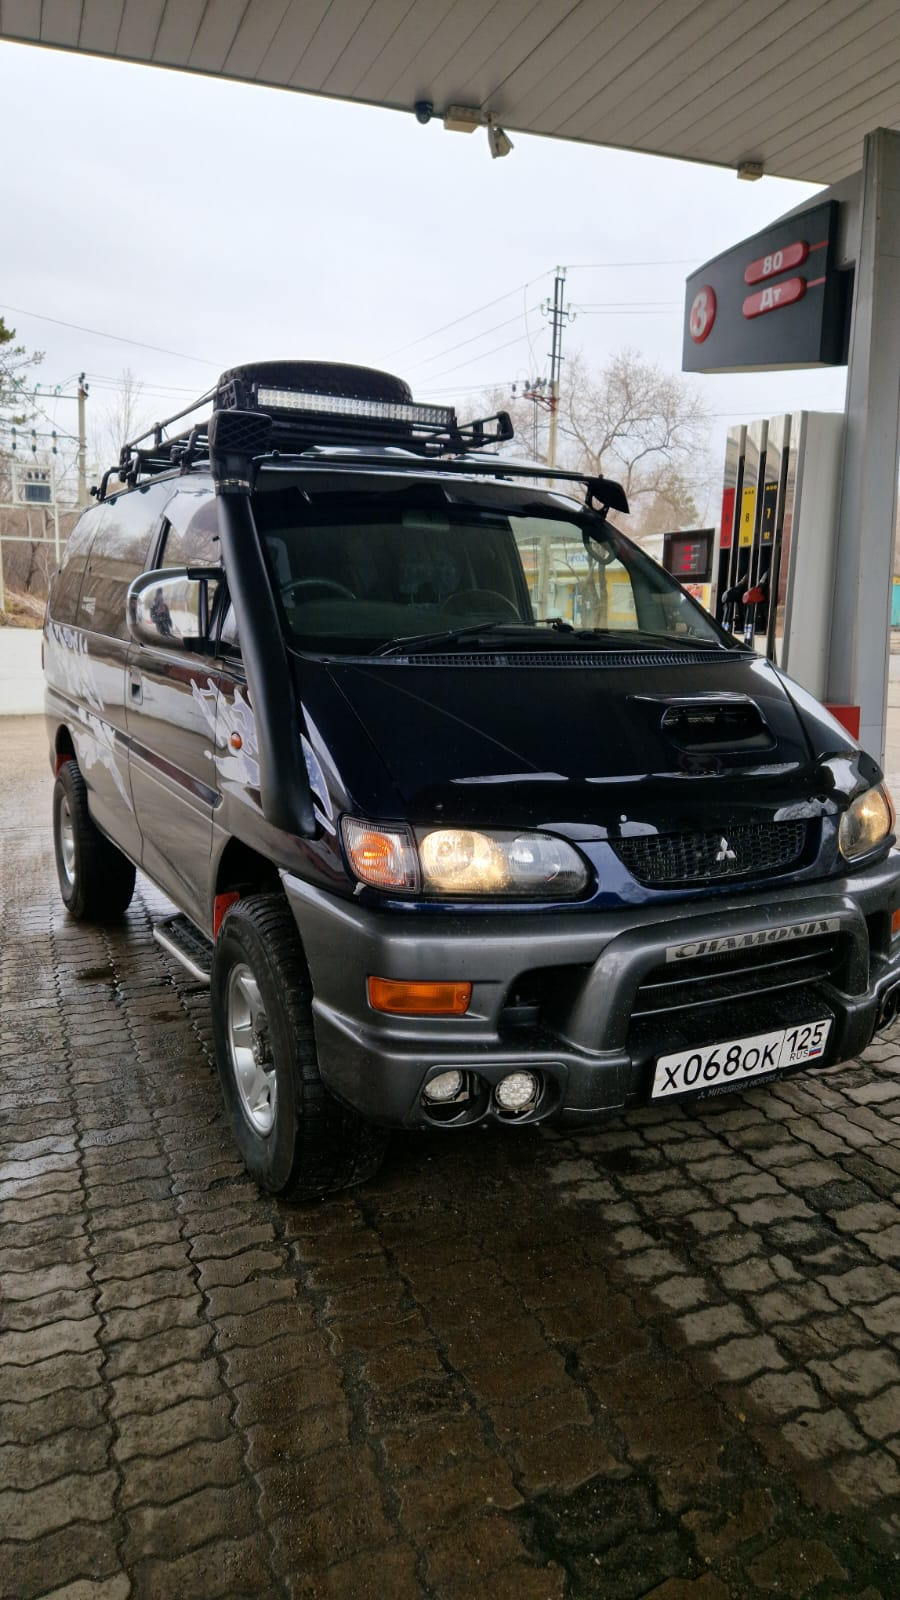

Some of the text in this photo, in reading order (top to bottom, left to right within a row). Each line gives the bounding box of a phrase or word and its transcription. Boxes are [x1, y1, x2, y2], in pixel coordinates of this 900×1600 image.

[762, 251, 783, 275] 80
[675, 921, 830, 958] CHAMONIX
[787, 1023, 826, 1053] 125
[789, 1050, 809, 1062] RUS
